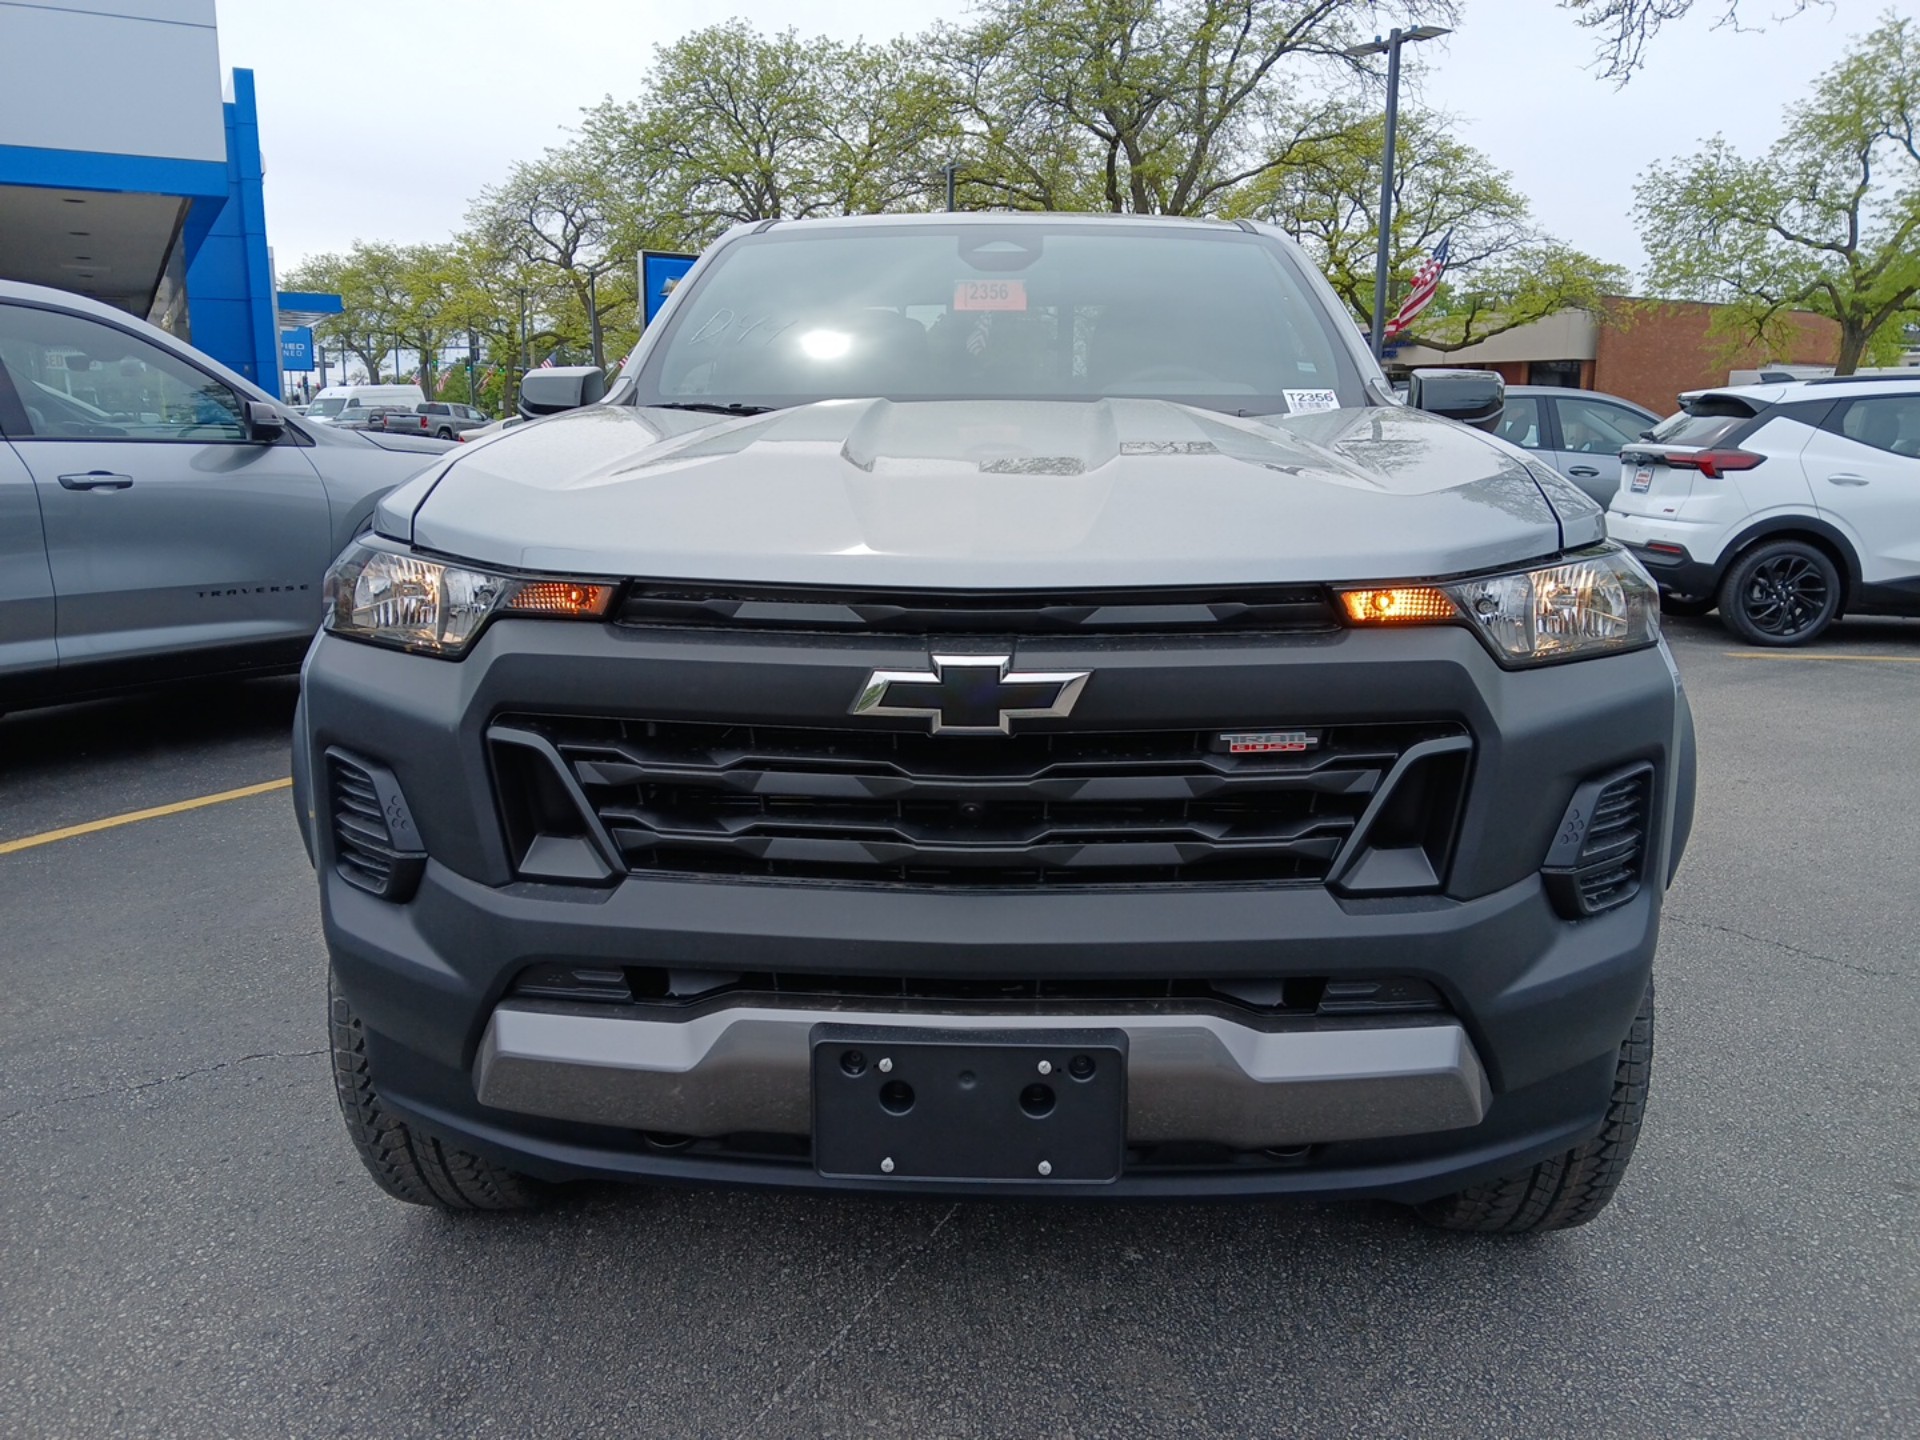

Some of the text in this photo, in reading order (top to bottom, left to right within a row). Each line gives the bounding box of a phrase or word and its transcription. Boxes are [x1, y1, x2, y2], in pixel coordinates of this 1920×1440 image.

[969, 283, 1009, 301] 2356
[1286, 392, 1334, 402] T2356
[196, 584, 309, 598] TRAVERSE
[1220, 732, 1318, 744] TRAIL
[1230, 743, 1306, 753] BOSS
